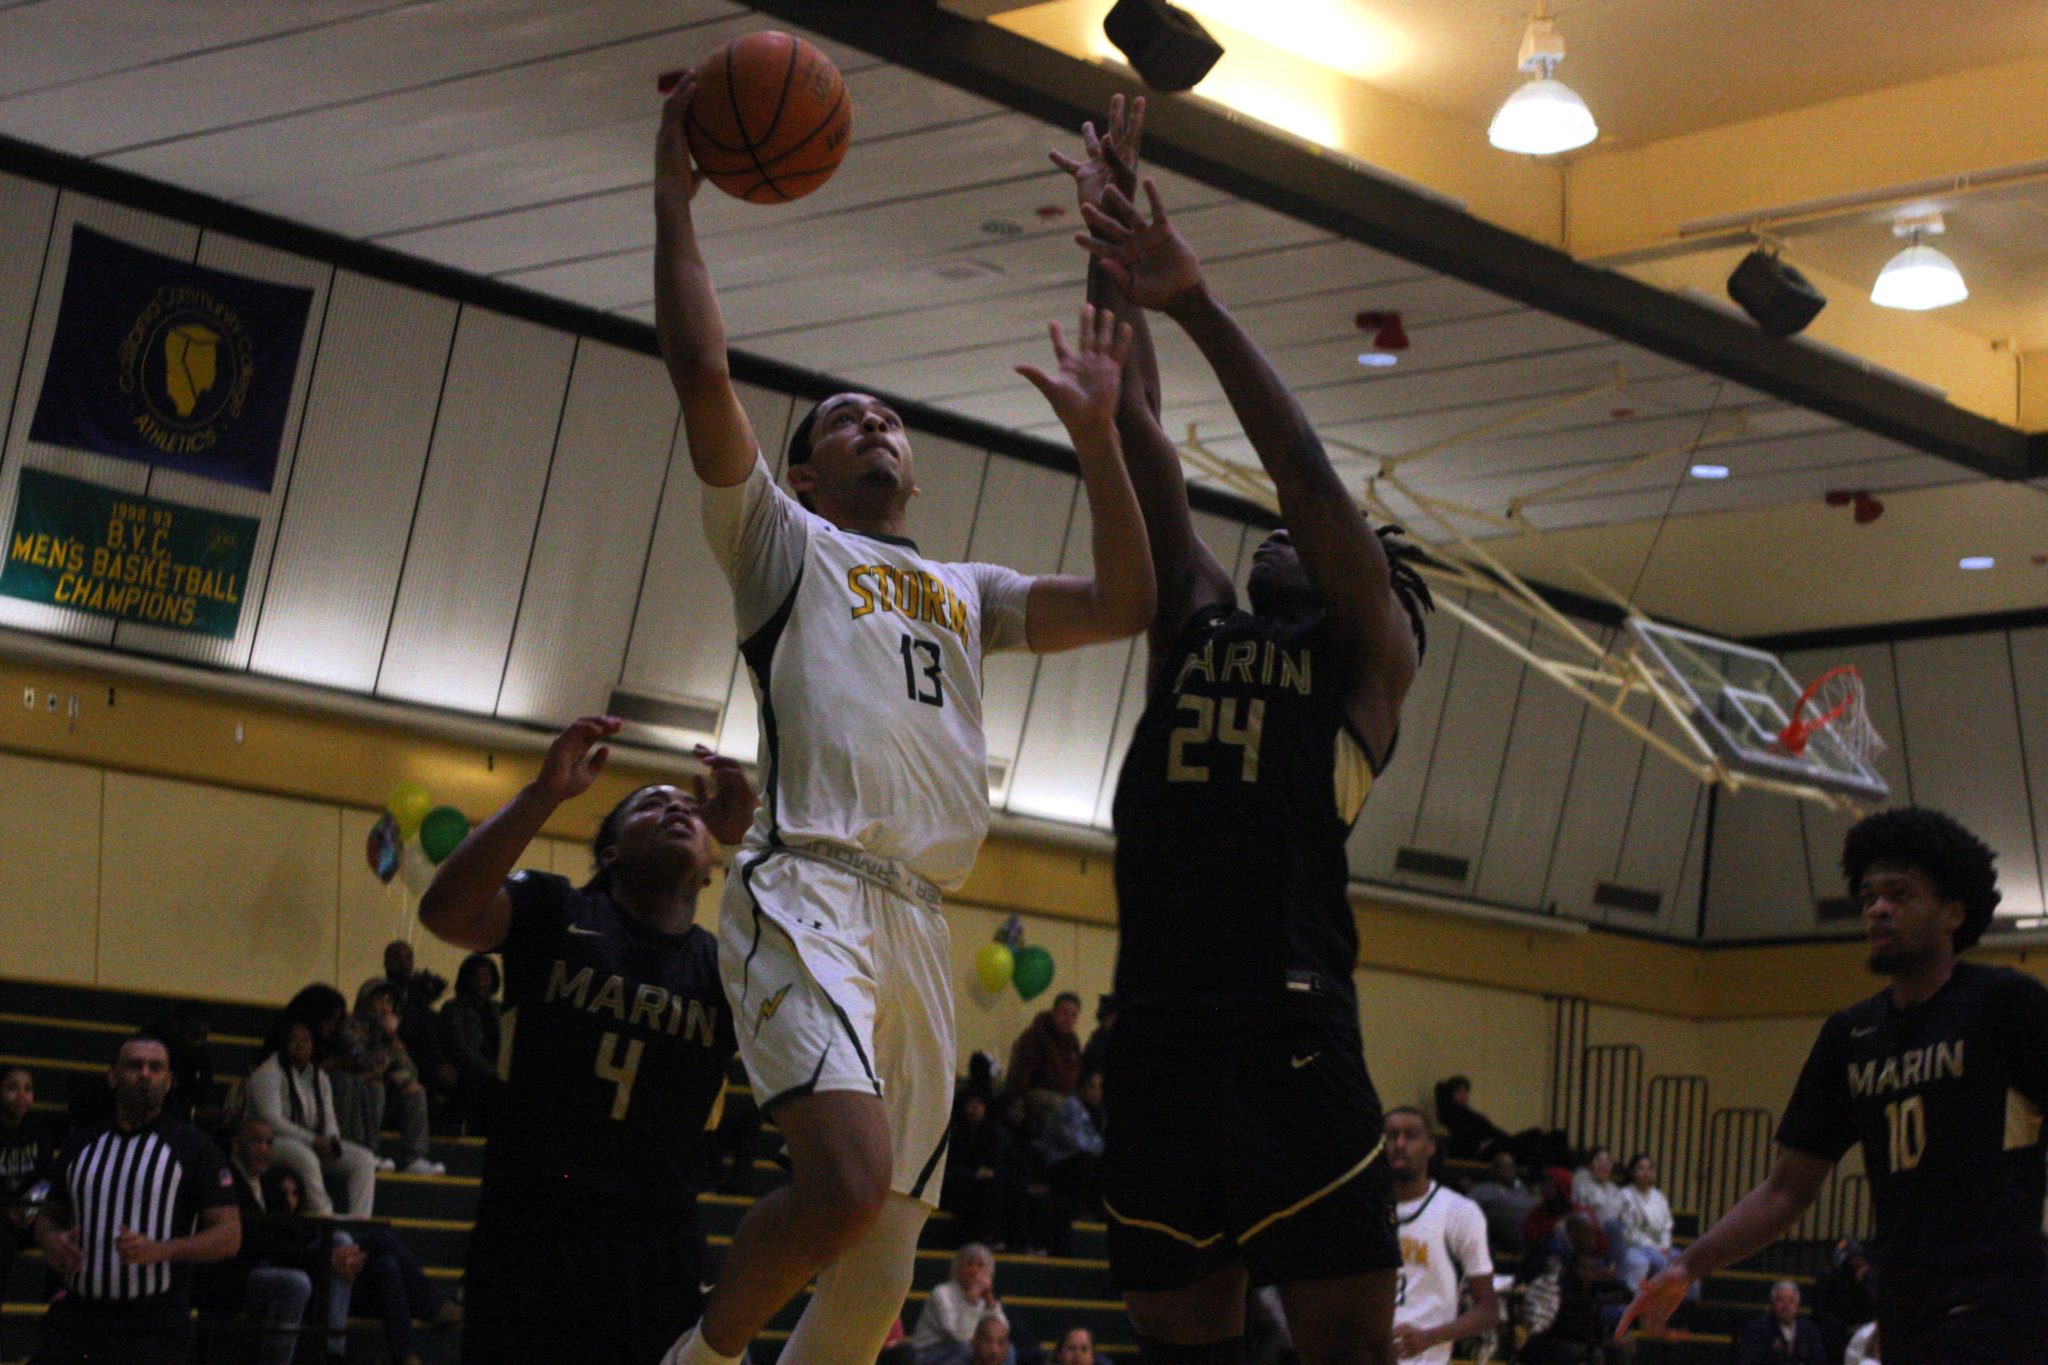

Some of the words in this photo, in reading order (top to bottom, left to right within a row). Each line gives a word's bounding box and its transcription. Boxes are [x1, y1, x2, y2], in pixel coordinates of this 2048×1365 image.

[54, 572, 197, 627] CHAMPIONS
[91, 546, 238, 604] BASKETBALL
[847, 564, 969, 653] STORM
[901, 634, 943, 707] 13
[1171, 638, 1313, 696] ARIN
[1166, 692, 1266, 783] 24
[544, 959, 718, 1047] MARIN
[593, 1030, 646, 1121] 4
[1846, 1038, 1966, 1097] MARIN
[1883, 1093, 1927, 1174] 10
